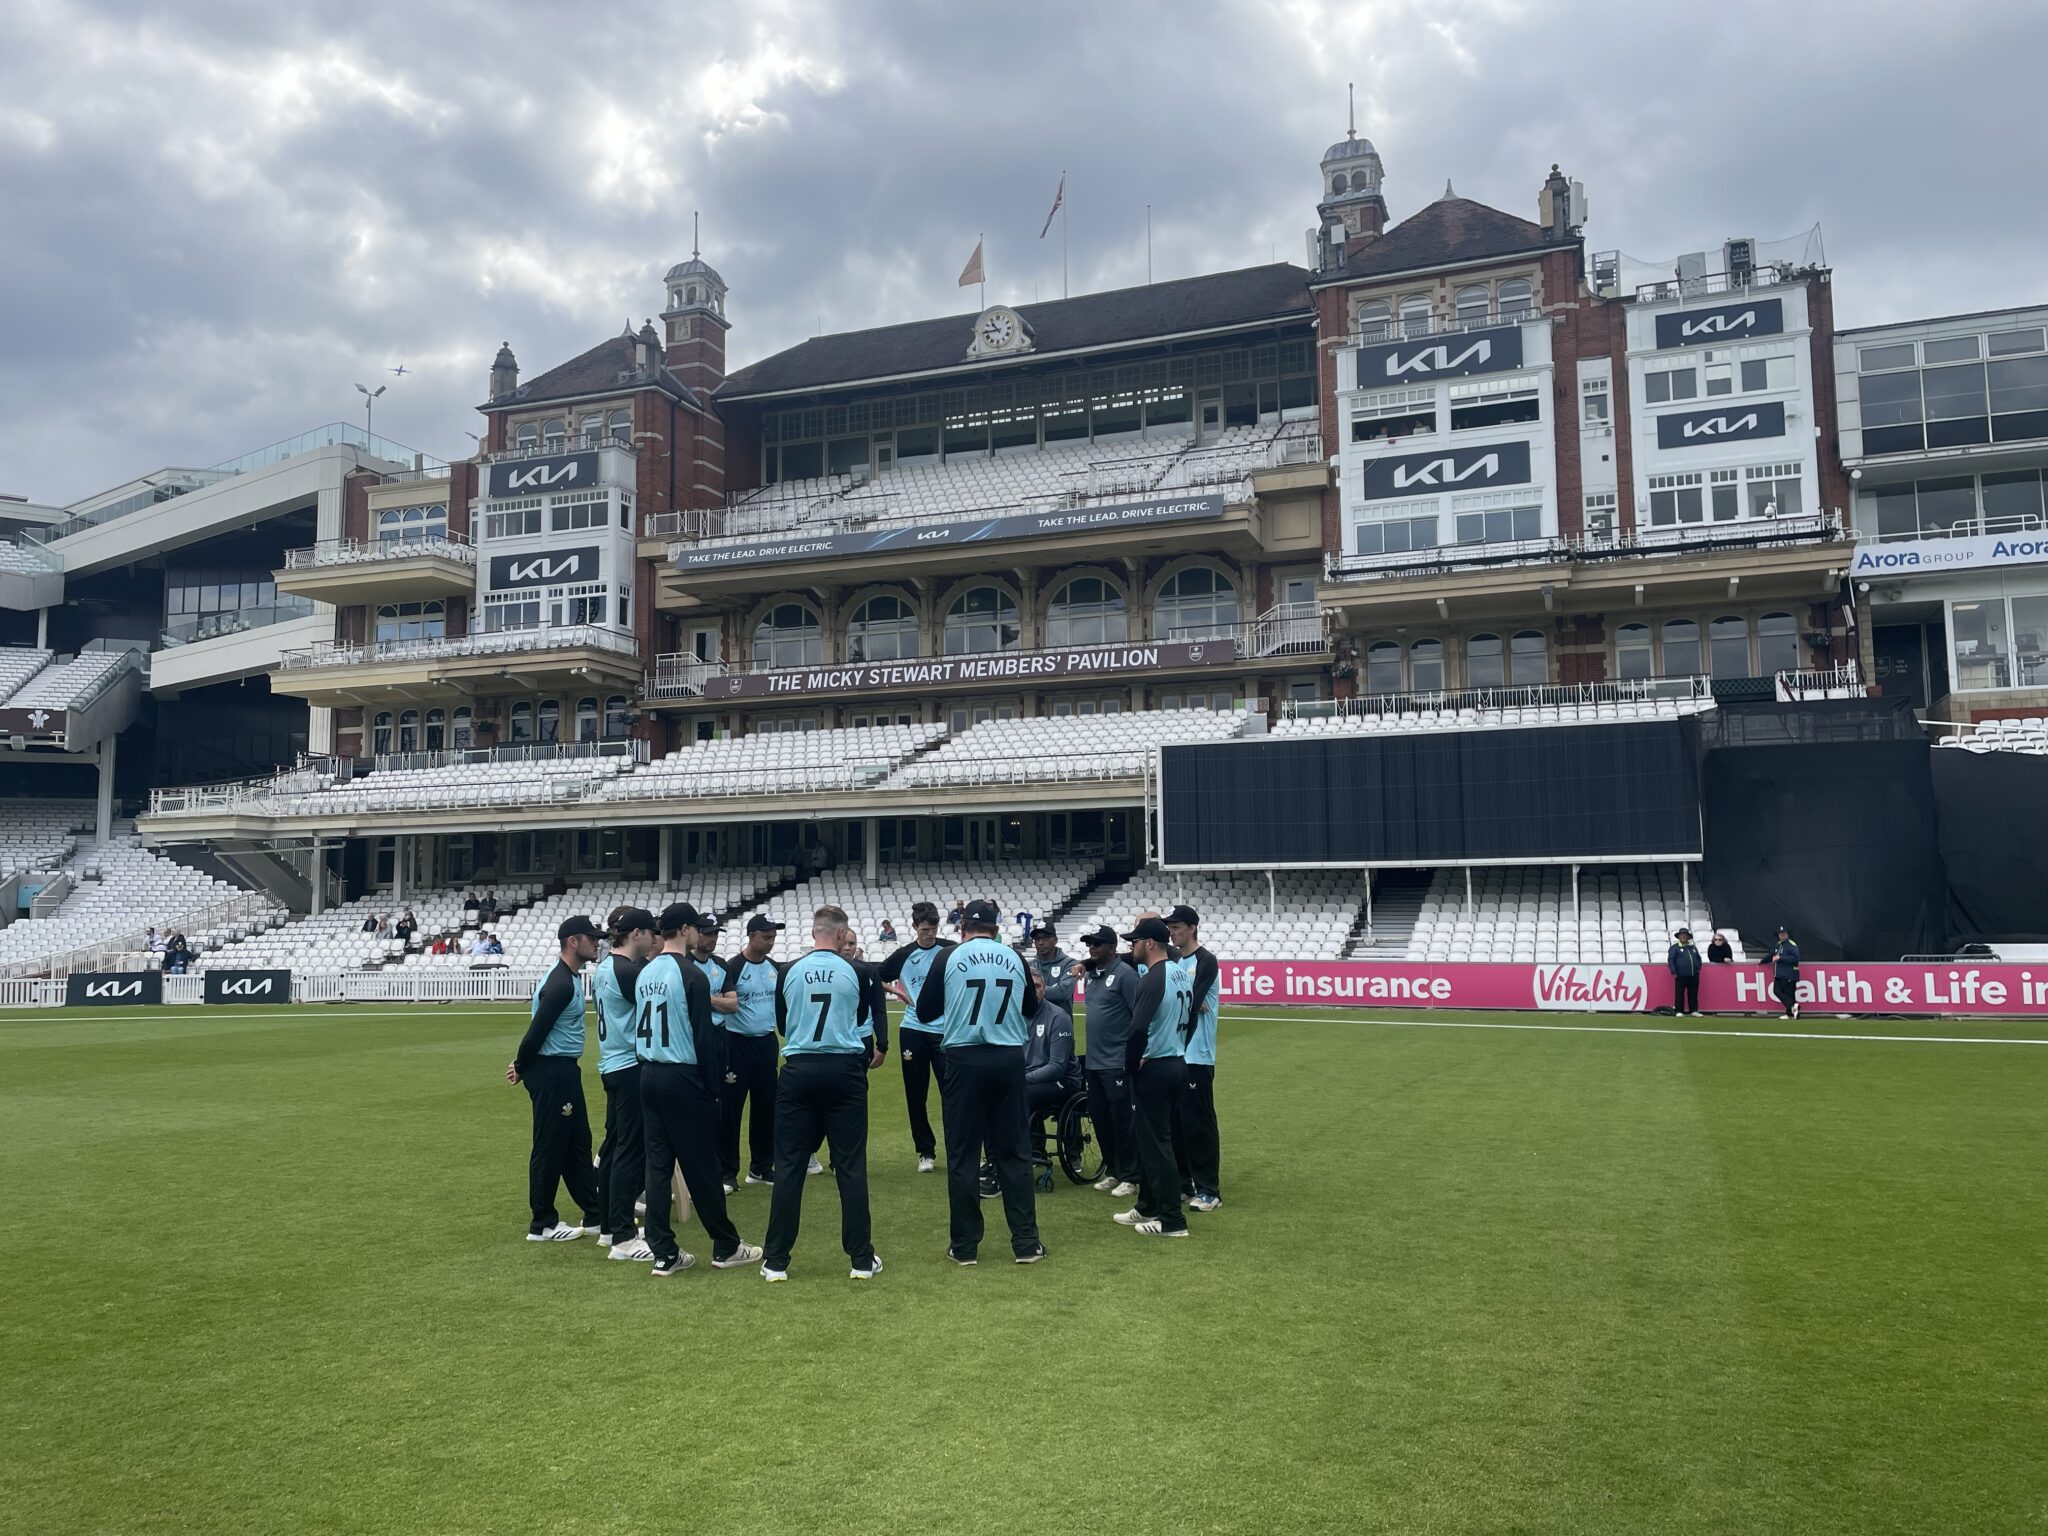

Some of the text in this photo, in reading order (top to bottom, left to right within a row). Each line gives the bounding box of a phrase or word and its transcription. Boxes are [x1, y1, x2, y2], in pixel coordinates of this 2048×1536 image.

[1682, 310, 1756, 337] KIA
[1386, 339, 1492, 377] KIA
[1684, 413, 1757, 438] KIA
[508, 461, 578, 489] KIA
[1393, 453, 1499, 489] KIA
[1037, 502, 1210, 528] TAKE THE LEAD. DRIVE ELECTRIC.
[688, 541, 833, 563] TAKE THE LEAD. DRIVE ELECTRIC.
[1857, 551, 1974, 570] Arora GROUP
[510, 554, 579, 581] KIA
[768, 675, 803, 692] THE
[808, 669, 864, 688] MICKY
[868, 663, 955, 683] STEWART
[1067, 648, 1158, 671] PAVILION
[86, 980, 142, 997] KIA
[221, 978, 272, 995] KIA
[640, 981, 668, 998] FISHER
[804, 969, 835, 985] GALE
[1218, 966, 1452, 999] Life insurance
[1539, 963, 1642, 1011] Vitality
[1736, 970, 1872, 1003] Halth
[1884, 977, 1914, 1004] &
[1924, 970, 2007, 1005] Life
[966, 978, 1014, 1026] 77
[636, 1000, 670, 1048] 41
[810, 993, 832, 1042] 7
